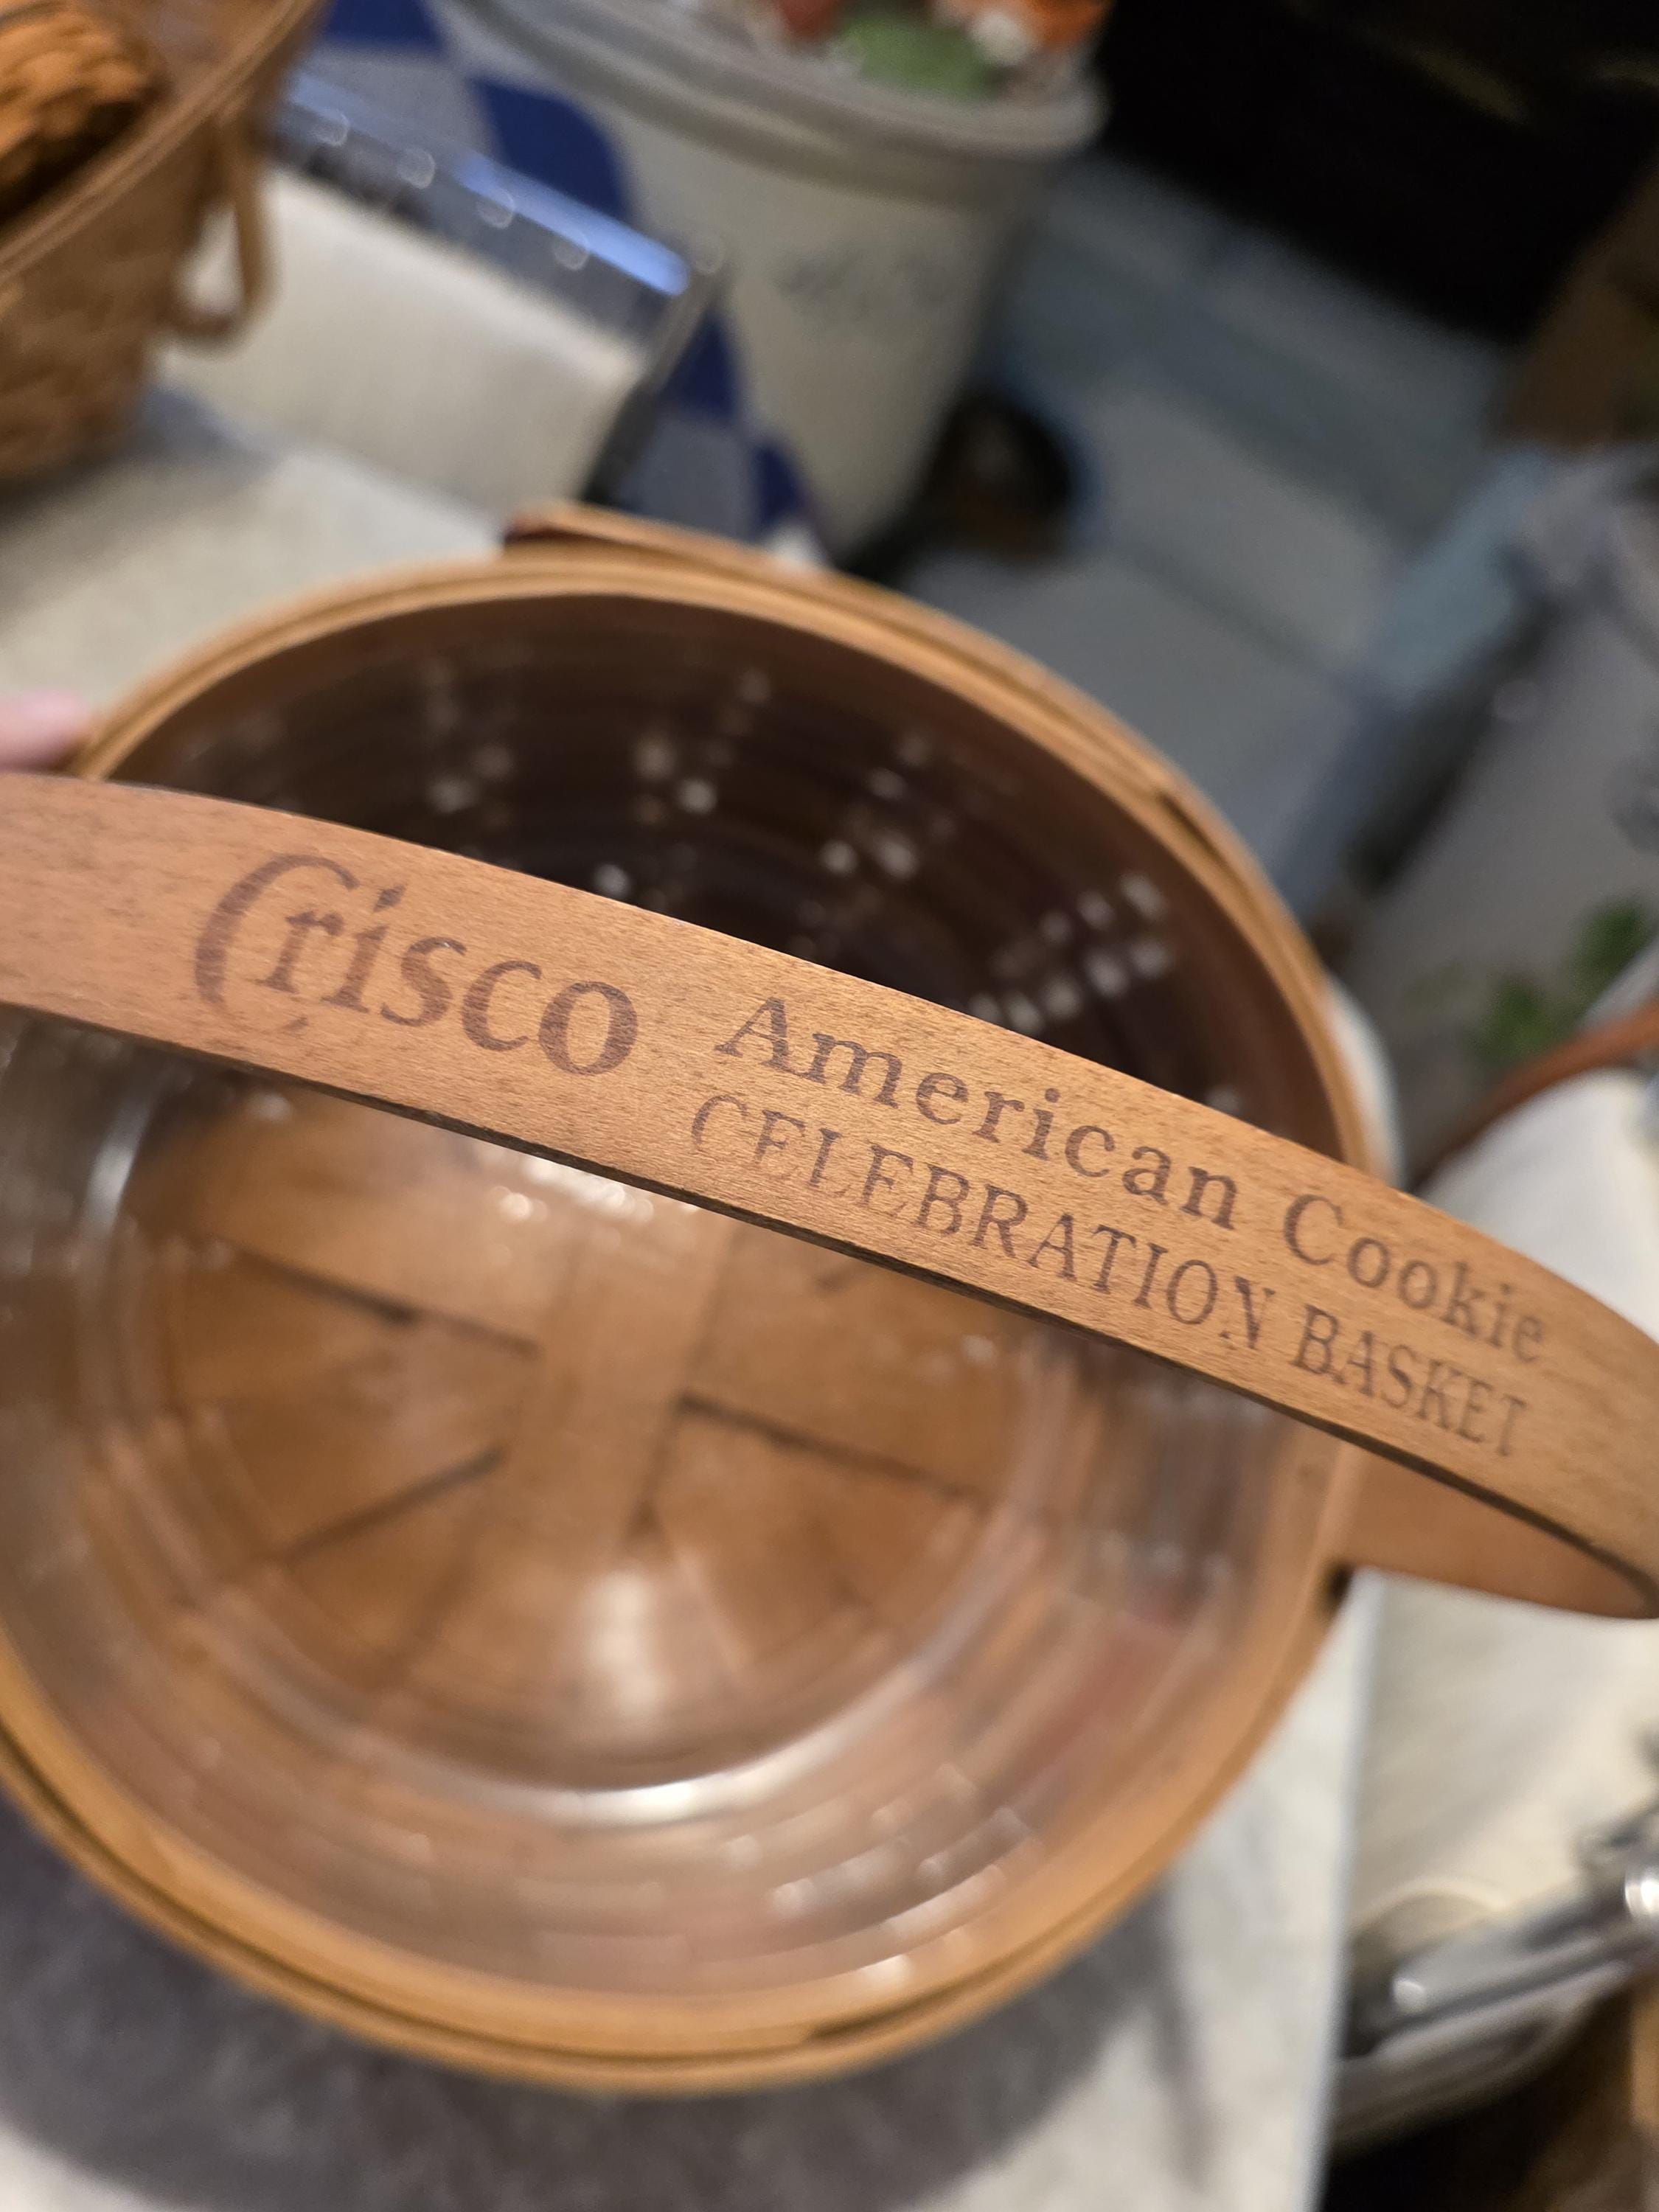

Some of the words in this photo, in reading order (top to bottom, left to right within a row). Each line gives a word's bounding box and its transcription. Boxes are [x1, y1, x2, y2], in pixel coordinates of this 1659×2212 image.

[195, 853, 639, 1076] Crisco
[690, 1095, 1276, 1349] CELEBRATION
[1290, 1304, 1527, 1456] BASKET
[714, 996, 1237, 1231] American
[1283, 1193, 1543, 1363] Cookie
